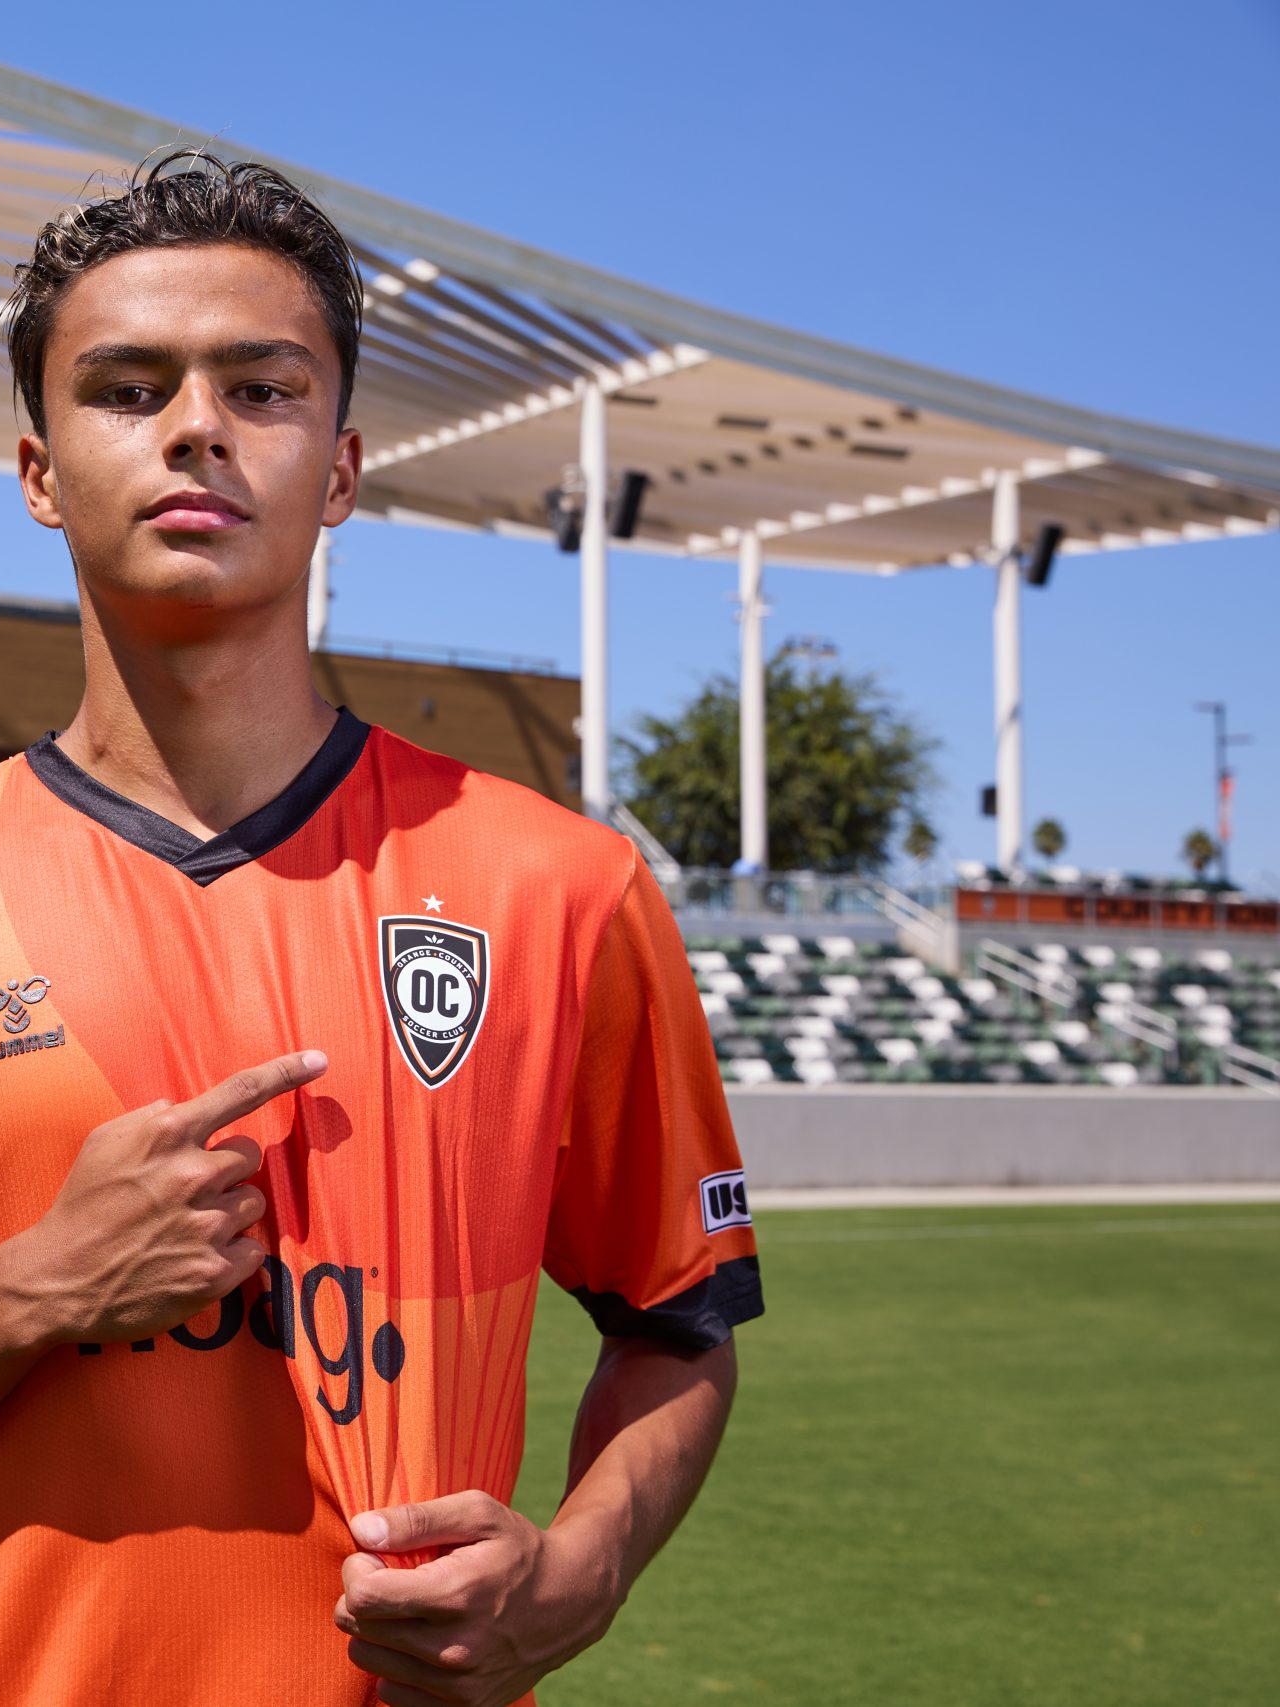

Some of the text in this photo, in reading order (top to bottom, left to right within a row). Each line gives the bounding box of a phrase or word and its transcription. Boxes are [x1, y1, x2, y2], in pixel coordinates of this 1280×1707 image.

[397, 950, 472, 978] ORANGE COUNTY
[411, 969, 459, 1018] OC
[402, 1015, 465, 1039] SOCCER CLUB
